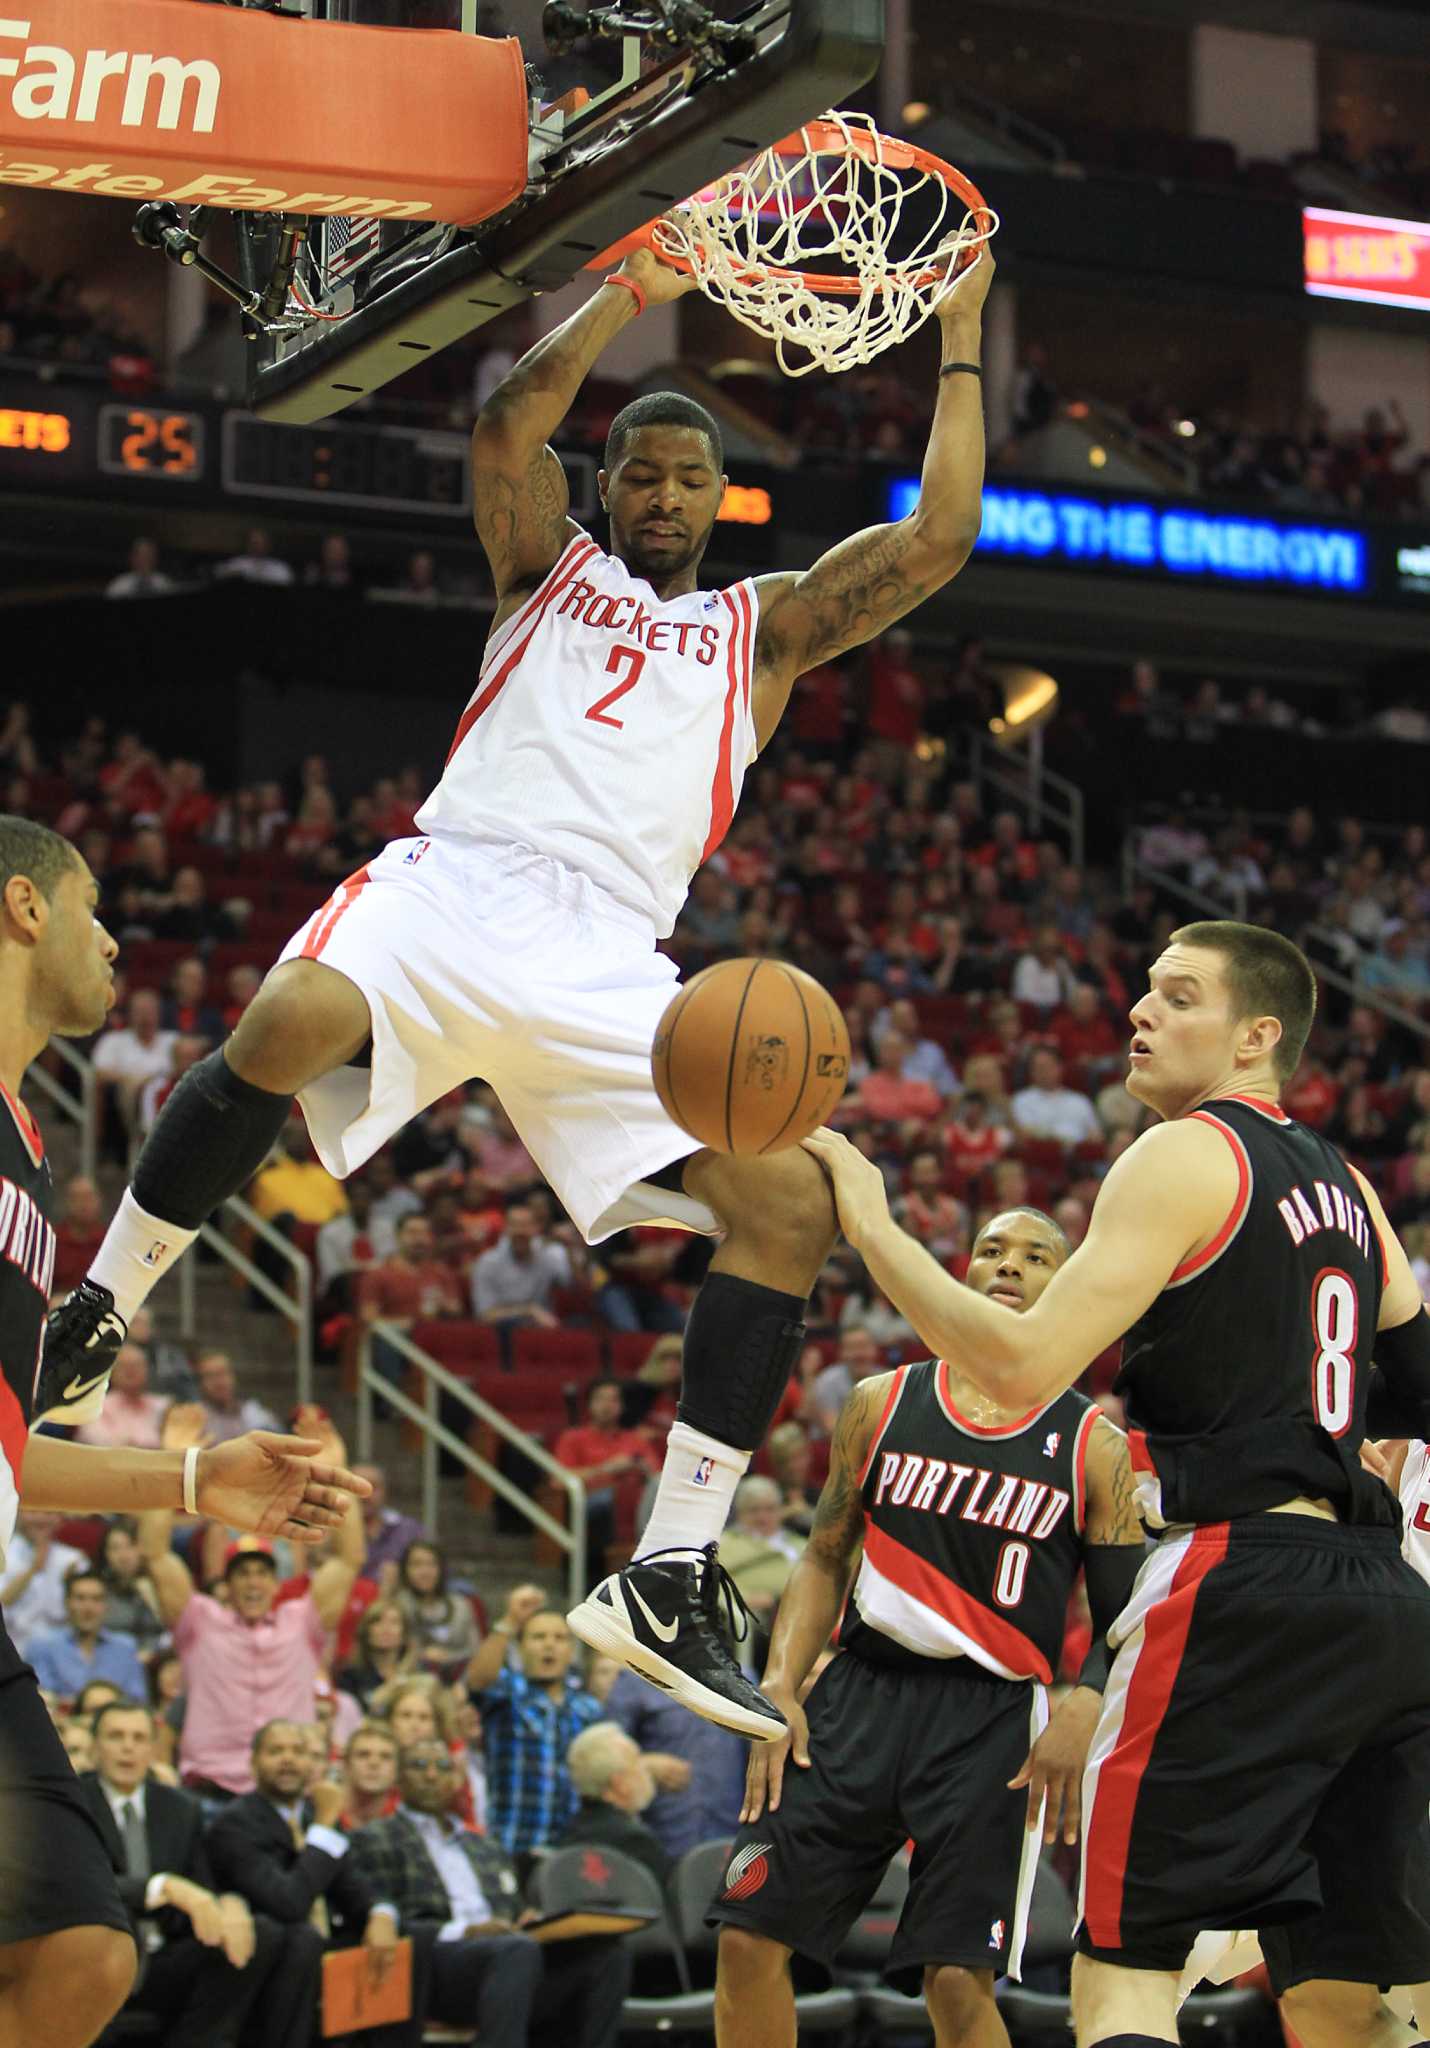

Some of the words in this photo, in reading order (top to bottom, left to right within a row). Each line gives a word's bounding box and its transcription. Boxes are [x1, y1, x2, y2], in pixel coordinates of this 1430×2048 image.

[0, 152, 165, 197] ate
[158, 173, 432, 217] Farm
[121, 410, 197, 475] 25
[1055, 500, 1155, 566] THE
[557, 577, 720, 666] ROCKETS
[585, 644, 646, 731] 2
[1312, 1266, 1359, 1440] 8
[873, 1451, 1071, 1540] PORTLAND
[992, 1540, 1032, 1609] 0
